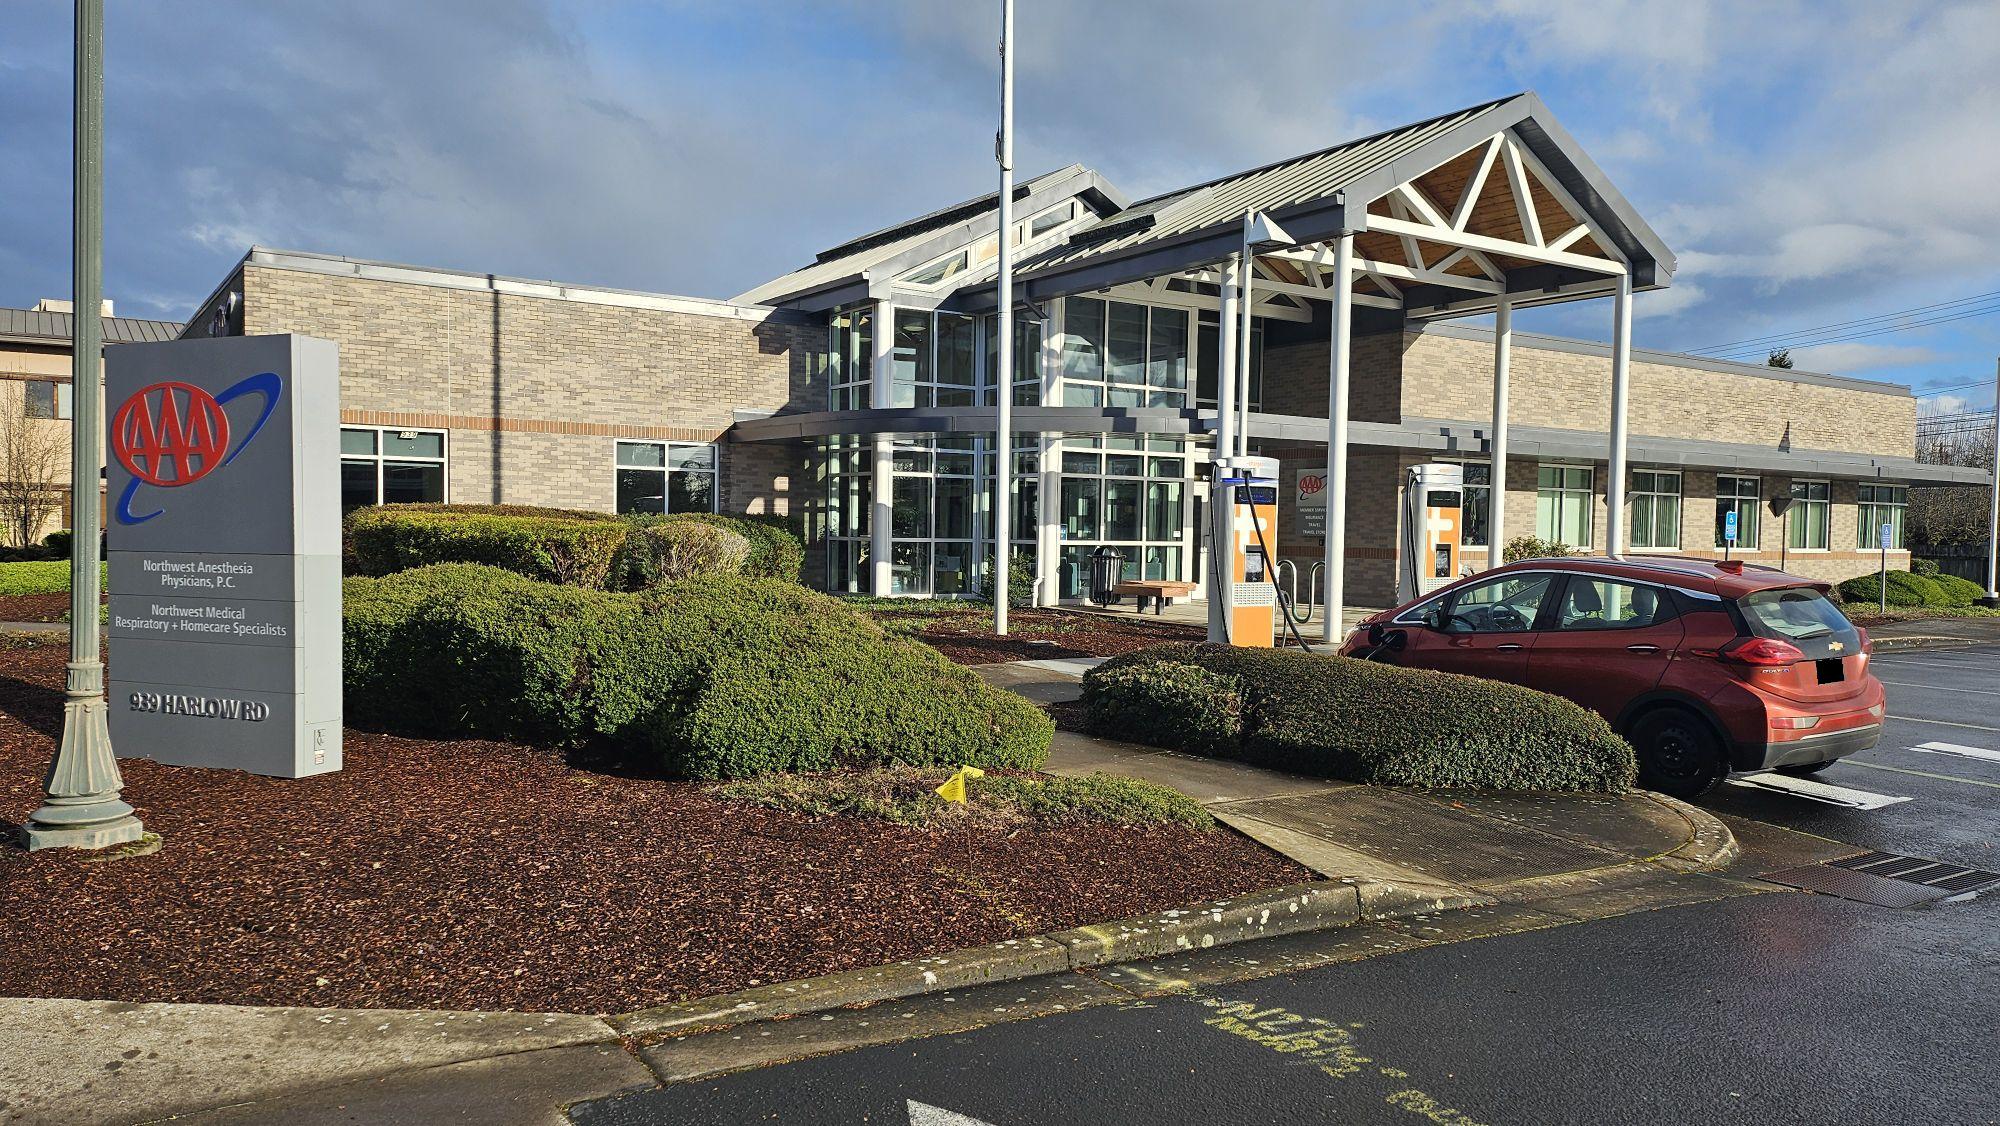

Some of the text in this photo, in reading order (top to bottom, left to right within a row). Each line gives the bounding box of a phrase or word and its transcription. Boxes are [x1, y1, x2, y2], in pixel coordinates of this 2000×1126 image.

[118, 384, 223, 484] AAA
[1301, 475, 1321, 494] AAA
[143, 559, 253, 575] Northwest Anesthesia
[161, 574, 236, 589] Physicians, P.C.
[151, 604, 245, 620] Northwest Medical
[115, 616, 170, 632] Respiratory
[180, 620, 231, 633] Homecare
[233, 621, 287, 637] Specialists
[129, 692, 269, 721] 939 HARLOW RD
